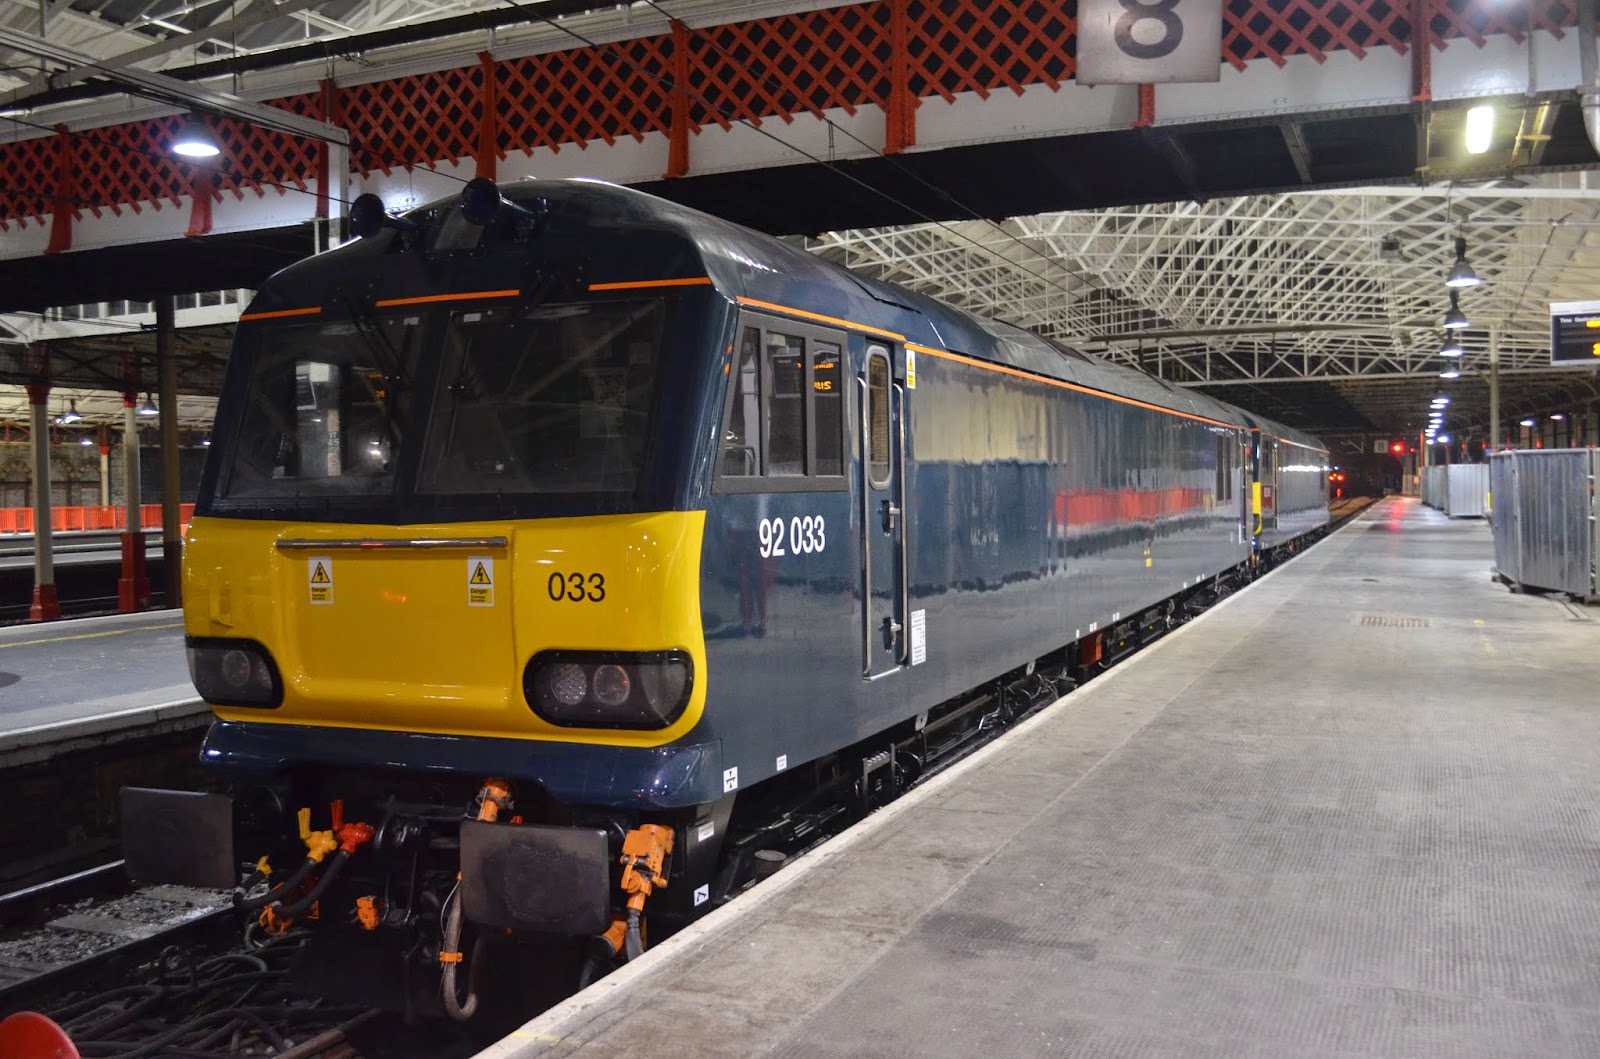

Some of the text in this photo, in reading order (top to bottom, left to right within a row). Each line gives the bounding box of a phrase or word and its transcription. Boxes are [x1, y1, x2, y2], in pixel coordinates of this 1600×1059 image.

[1114, 0, 1183, 59] 8
[759, 514, 826, 559] 92 033
[547, 571, 606, 602] 033
